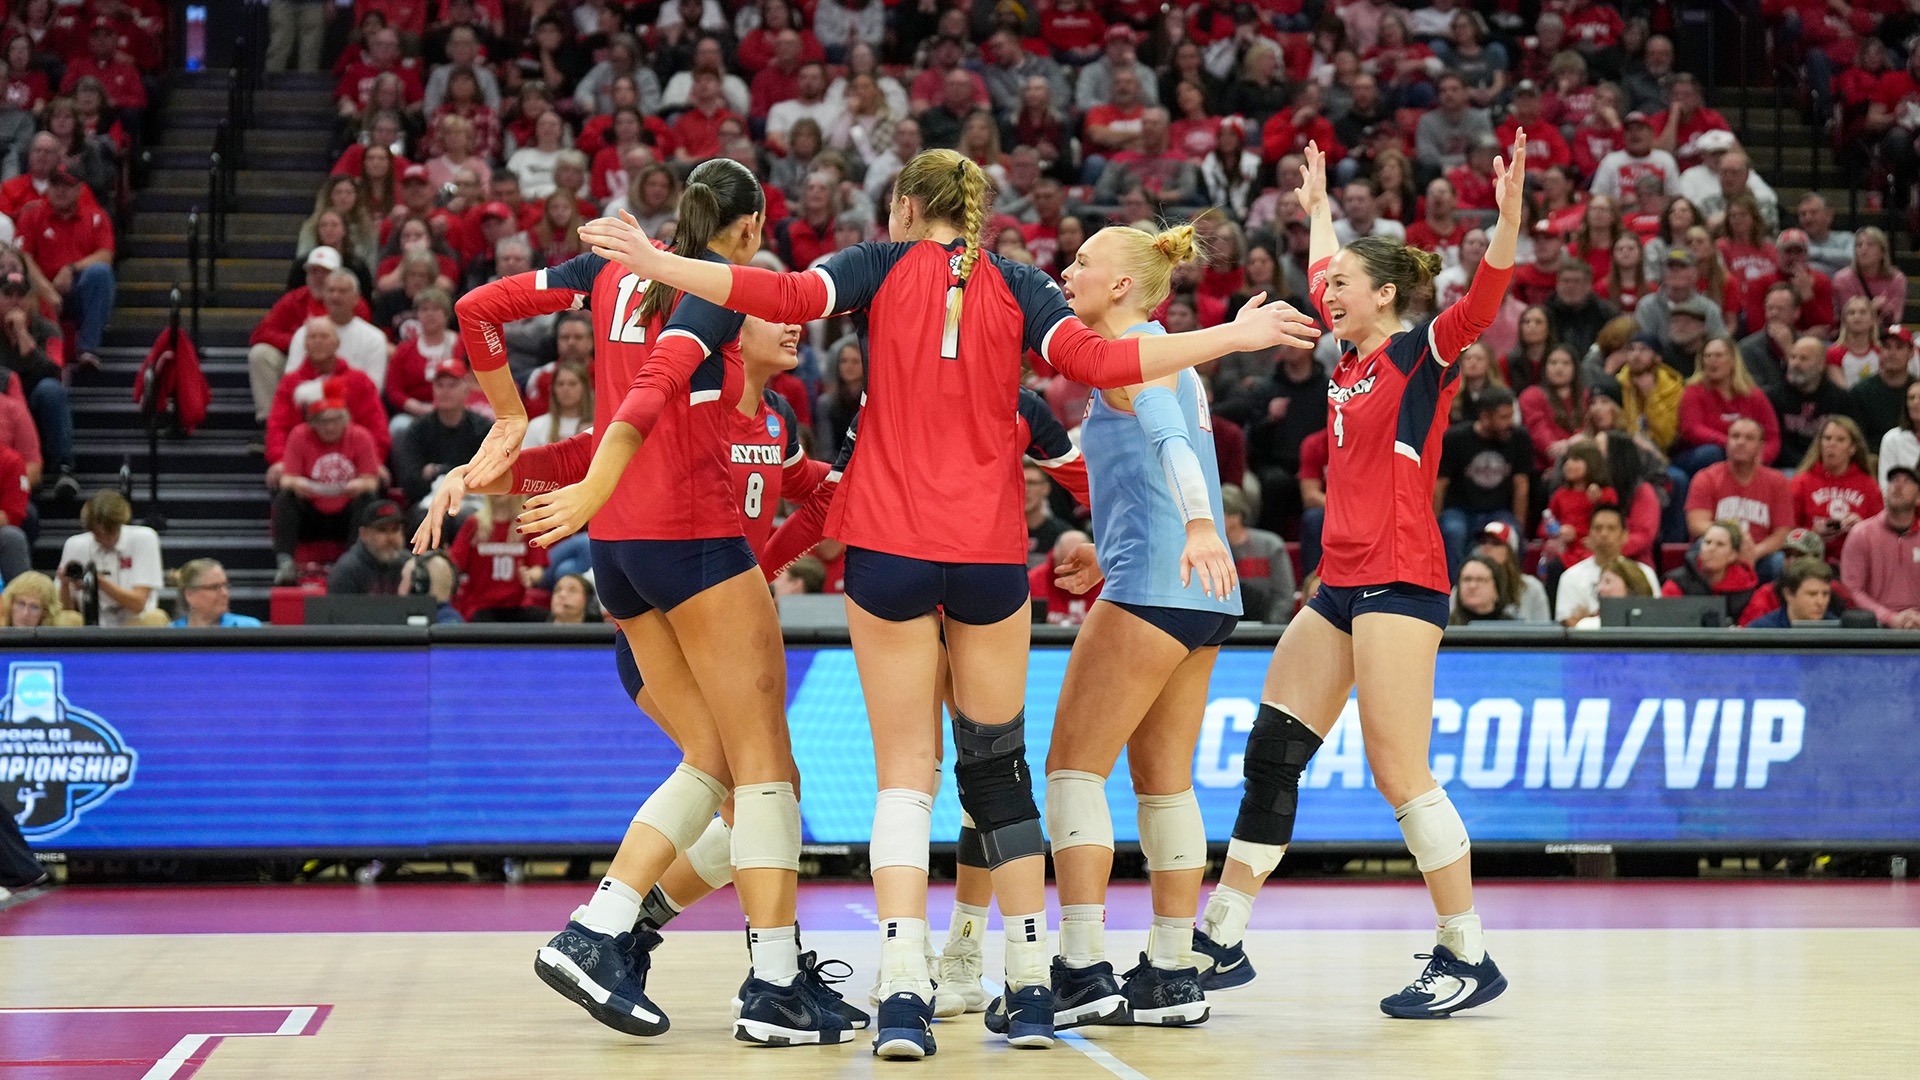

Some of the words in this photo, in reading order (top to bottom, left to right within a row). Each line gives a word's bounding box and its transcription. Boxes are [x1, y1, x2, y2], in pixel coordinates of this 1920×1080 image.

[608, 272, 652, 343] 12
[940, 285, 960, 359] 1
[1334, 404, 1345, 447] 4
[730, 444, 782, 465] AYTON
[521, 479, 546, 492] FLYER
[744, 471, 764, 519] 8
[492, 556, 514, 580] 10
[1195, 698, 1805, 789] CACOM/VIP
[0, 754, 129, 782] PIONSHIP
[801, 844, 850, 855] TRONICS
